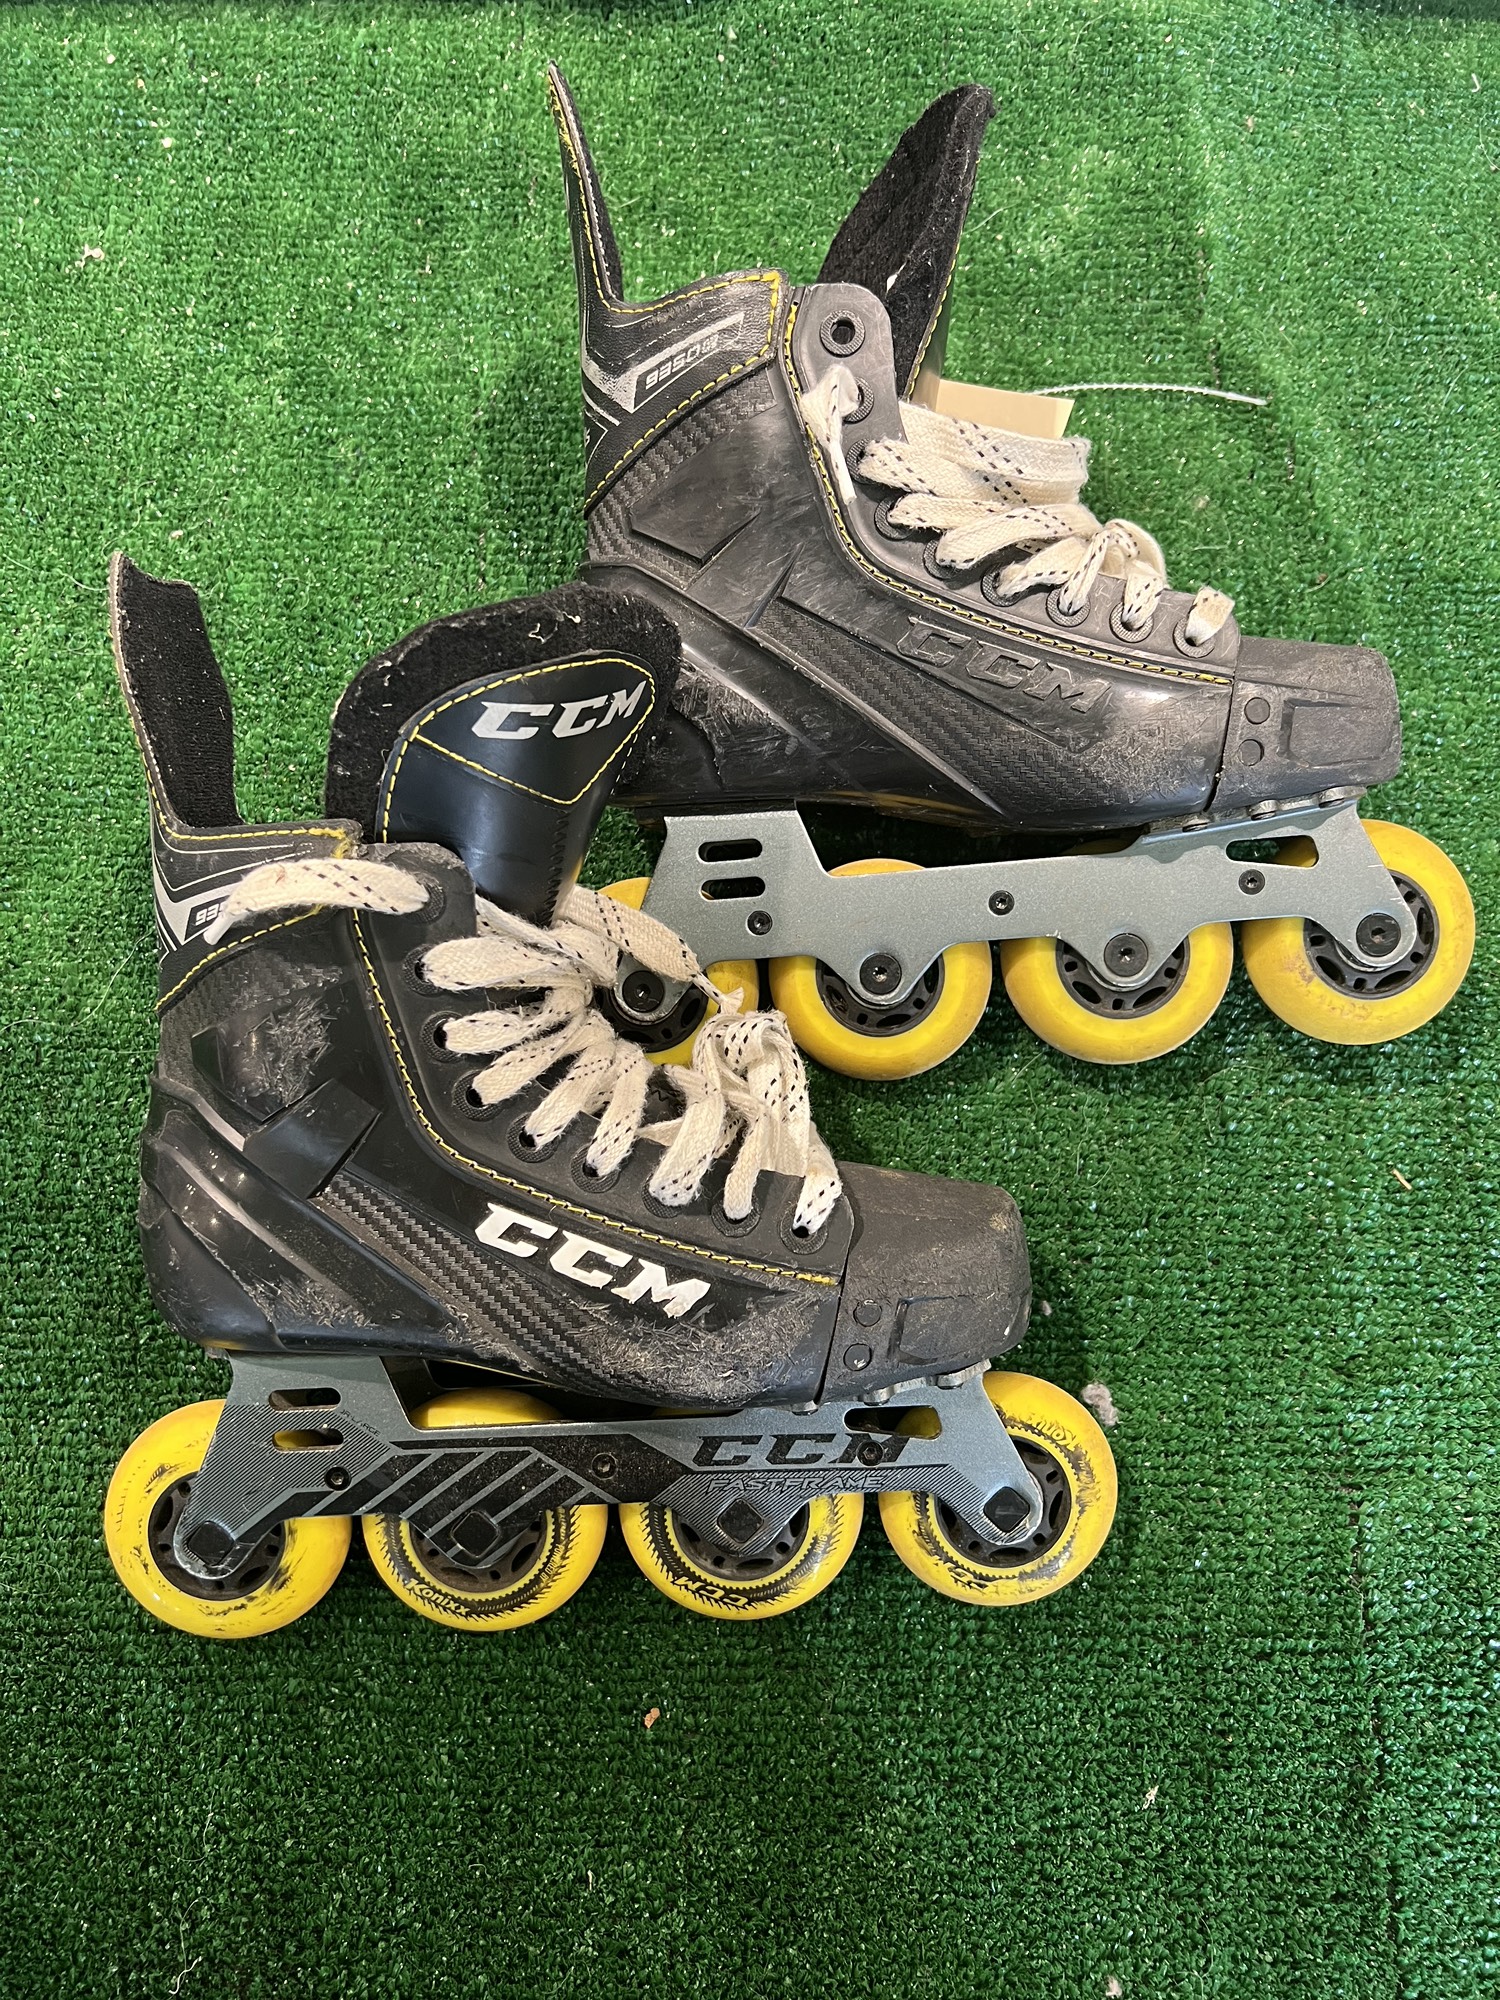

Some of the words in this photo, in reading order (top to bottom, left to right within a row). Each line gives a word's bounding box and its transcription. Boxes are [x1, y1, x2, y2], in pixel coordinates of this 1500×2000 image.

[896, 615, 1112, 714] CCM
[471, 680, 647, 740] CCM
[474, 1202, 712, 1320] CCM
[707, 1475, 886, 1492] FASTFRAME
[404, 1577, 471, 1616] Konixx
[673, 1575, 749, 1607] CCM
